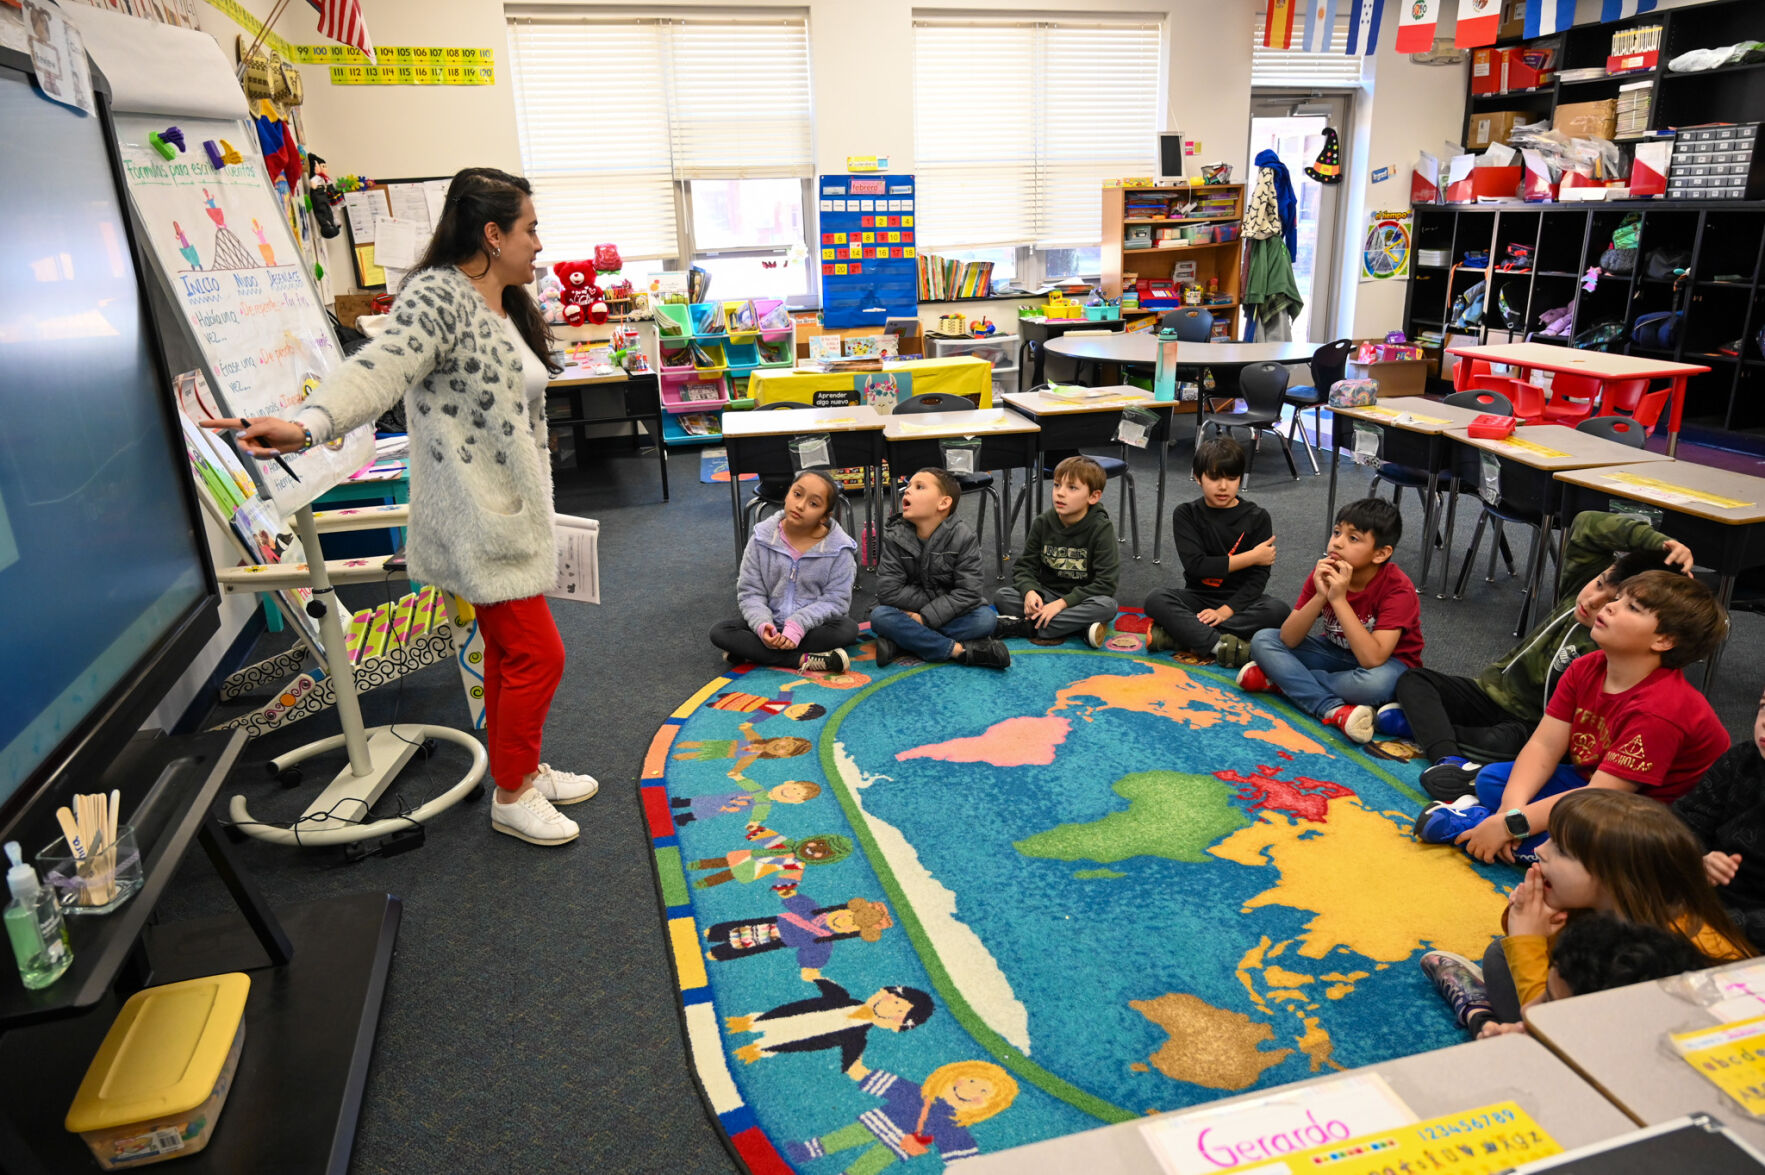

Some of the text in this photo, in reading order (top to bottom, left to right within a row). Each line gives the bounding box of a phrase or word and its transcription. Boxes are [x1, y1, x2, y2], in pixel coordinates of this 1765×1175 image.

[297, 47, 360, 56] 99 100 101 102
[380, 48, 394, 56] 104
[397, 48, 411, 57] 105
[413, 48, 427, 57] 106
[430, 48, 443, 57] 107
[446, 49, 460, 57] 108
[462, 49, 475, 57] 109
[479, 49, 490, 57] 110
[334, 68, 344, 76] 111
[349, 68, 361, 76] 112
[366, 68, 378, 76] 113
[382, 68, 394, 76] 114
[399, 68, 411, 76] 115
[415, 68, 427, 76] 116
[448, 68, 460, 76] 118
[479, 69, 492, 77] 120
[852, 183, 879, 192] febrero
[879, 218, 884, 226] 2
[890, 233, 898, 241] 10
[180, 275, 221, 297] INICIO
[818, 392, 847, 400] Aprender
[1197, 1108, 1350, 1169] Gerardo
